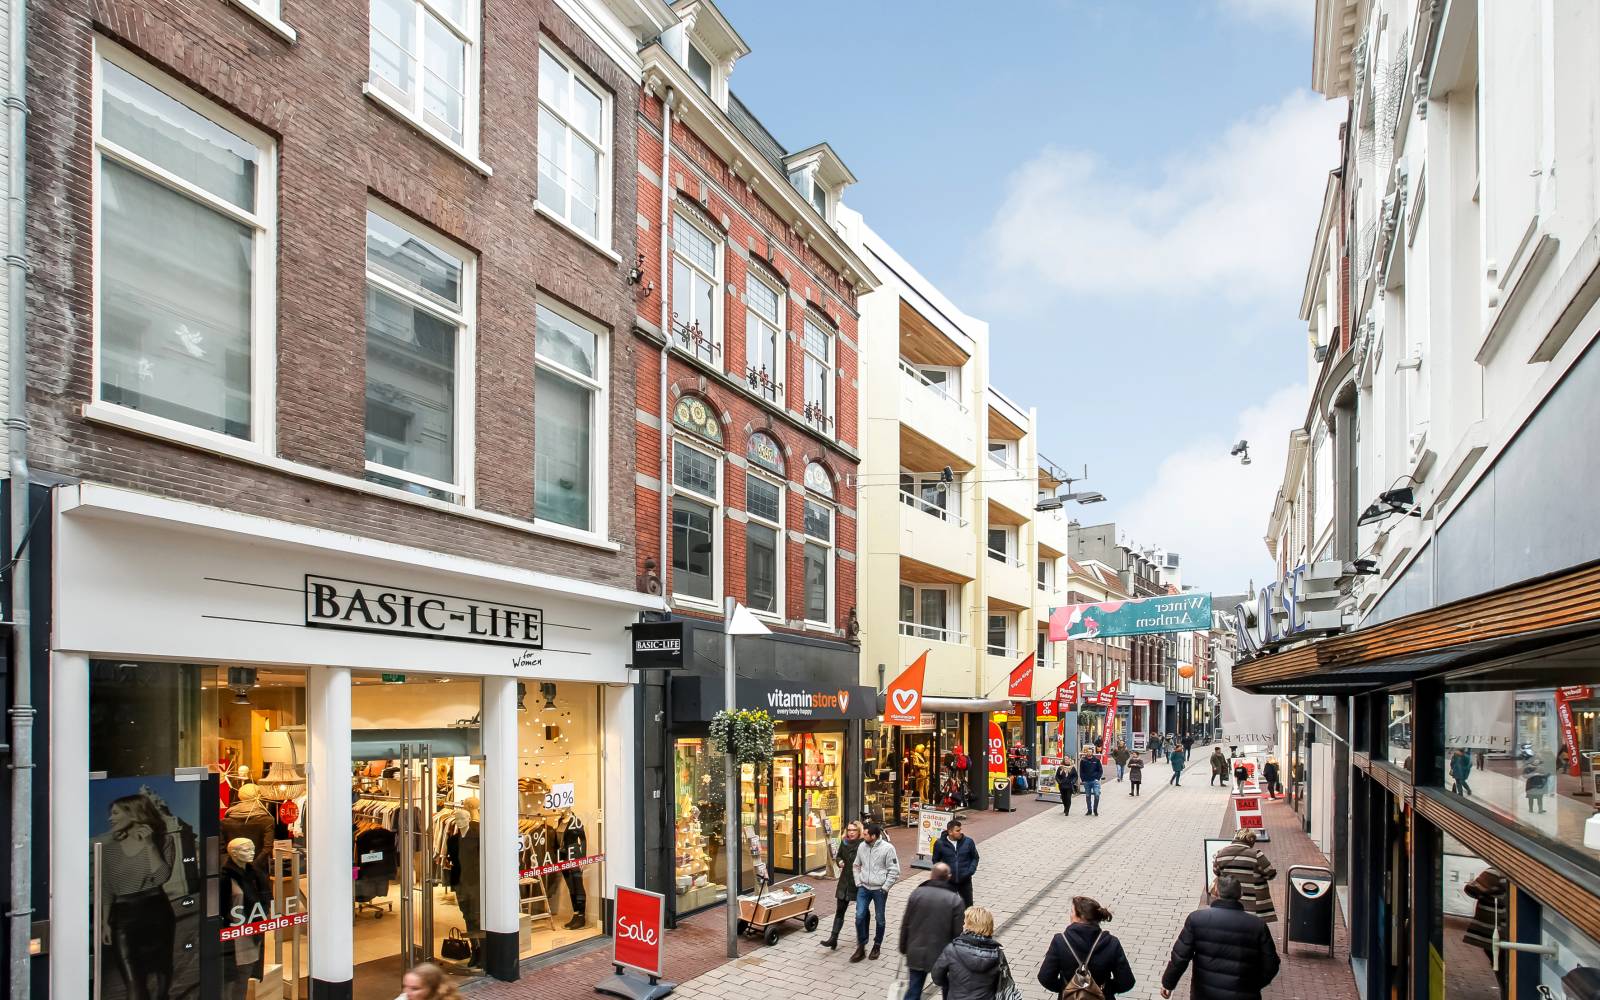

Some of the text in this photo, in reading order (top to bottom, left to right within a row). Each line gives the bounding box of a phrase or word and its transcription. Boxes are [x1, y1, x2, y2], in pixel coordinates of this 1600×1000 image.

[310, 582, 539, 641] BASIC-LIFE
[637, 640, 680, 649] BASIC-LIFE
[512, 658, 542, 668] Women
[522, 650, 535, 660] for
[767, 688, 837, 708] vitaminstore
[544, 790, 574, 809] 30%
[280, 808, 300, 817] SALE
[530, 846, 576, 869] SALE
[229, 895, 299, 927] SALE
[618, 916, 658, 946] Sale
